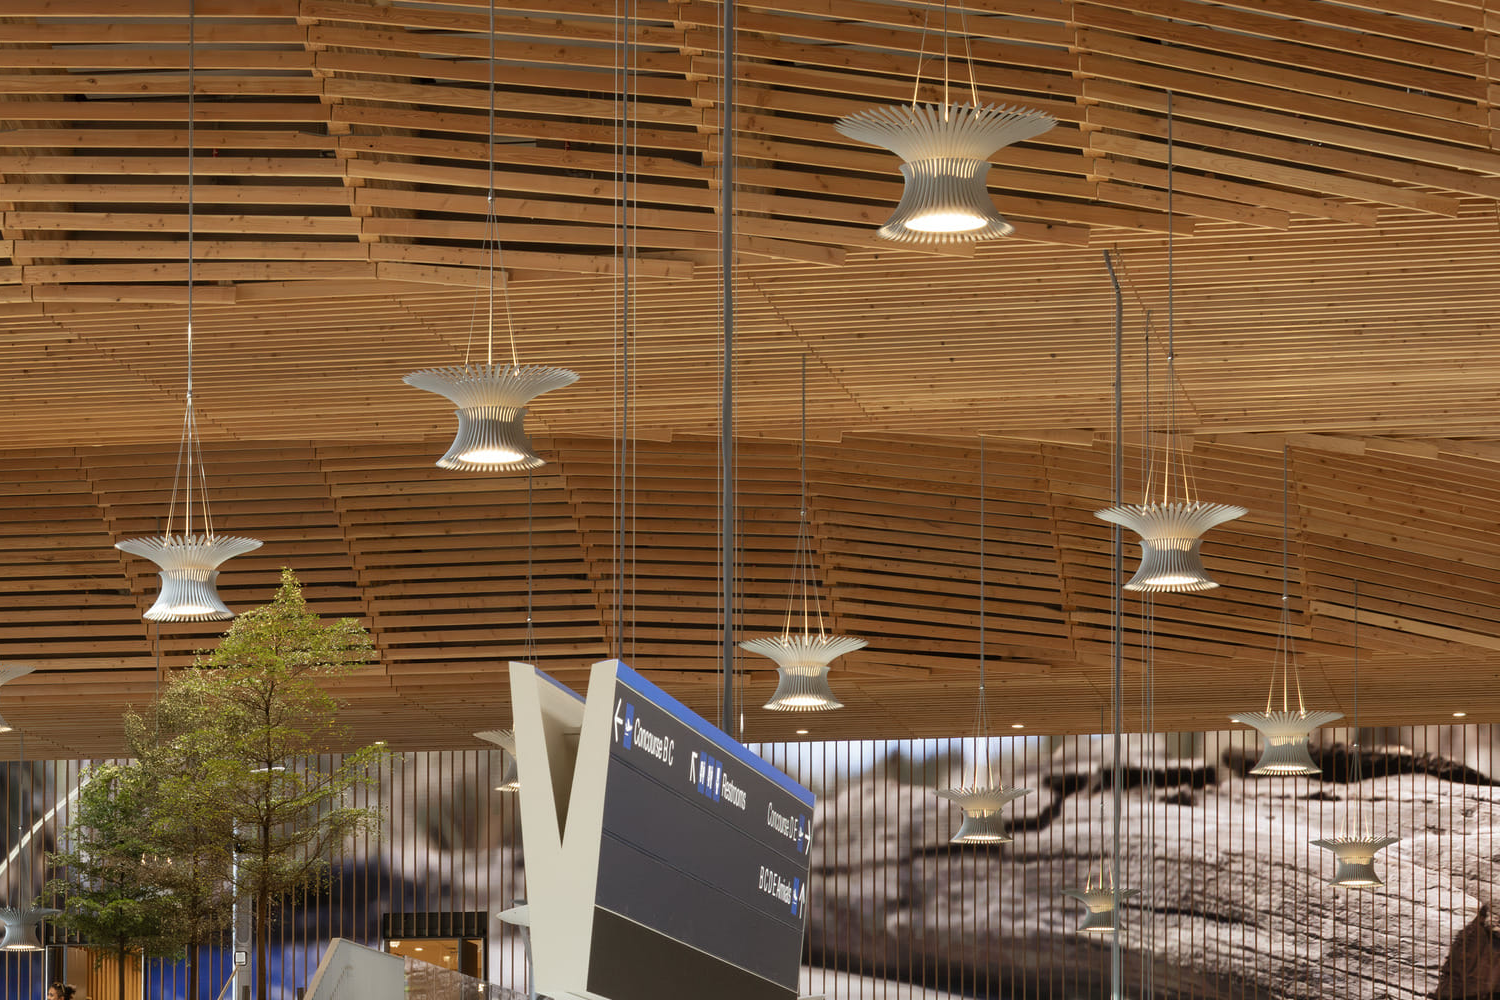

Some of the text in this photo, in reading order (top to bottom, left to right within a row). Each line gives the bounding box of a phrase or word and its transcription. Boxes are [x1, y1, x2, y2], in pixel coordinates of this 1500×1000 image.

[633, 717, 675, 766] Concourse B C
[721, 772, 747, 811] Restrooms
[792, 818, 799, 842] E
